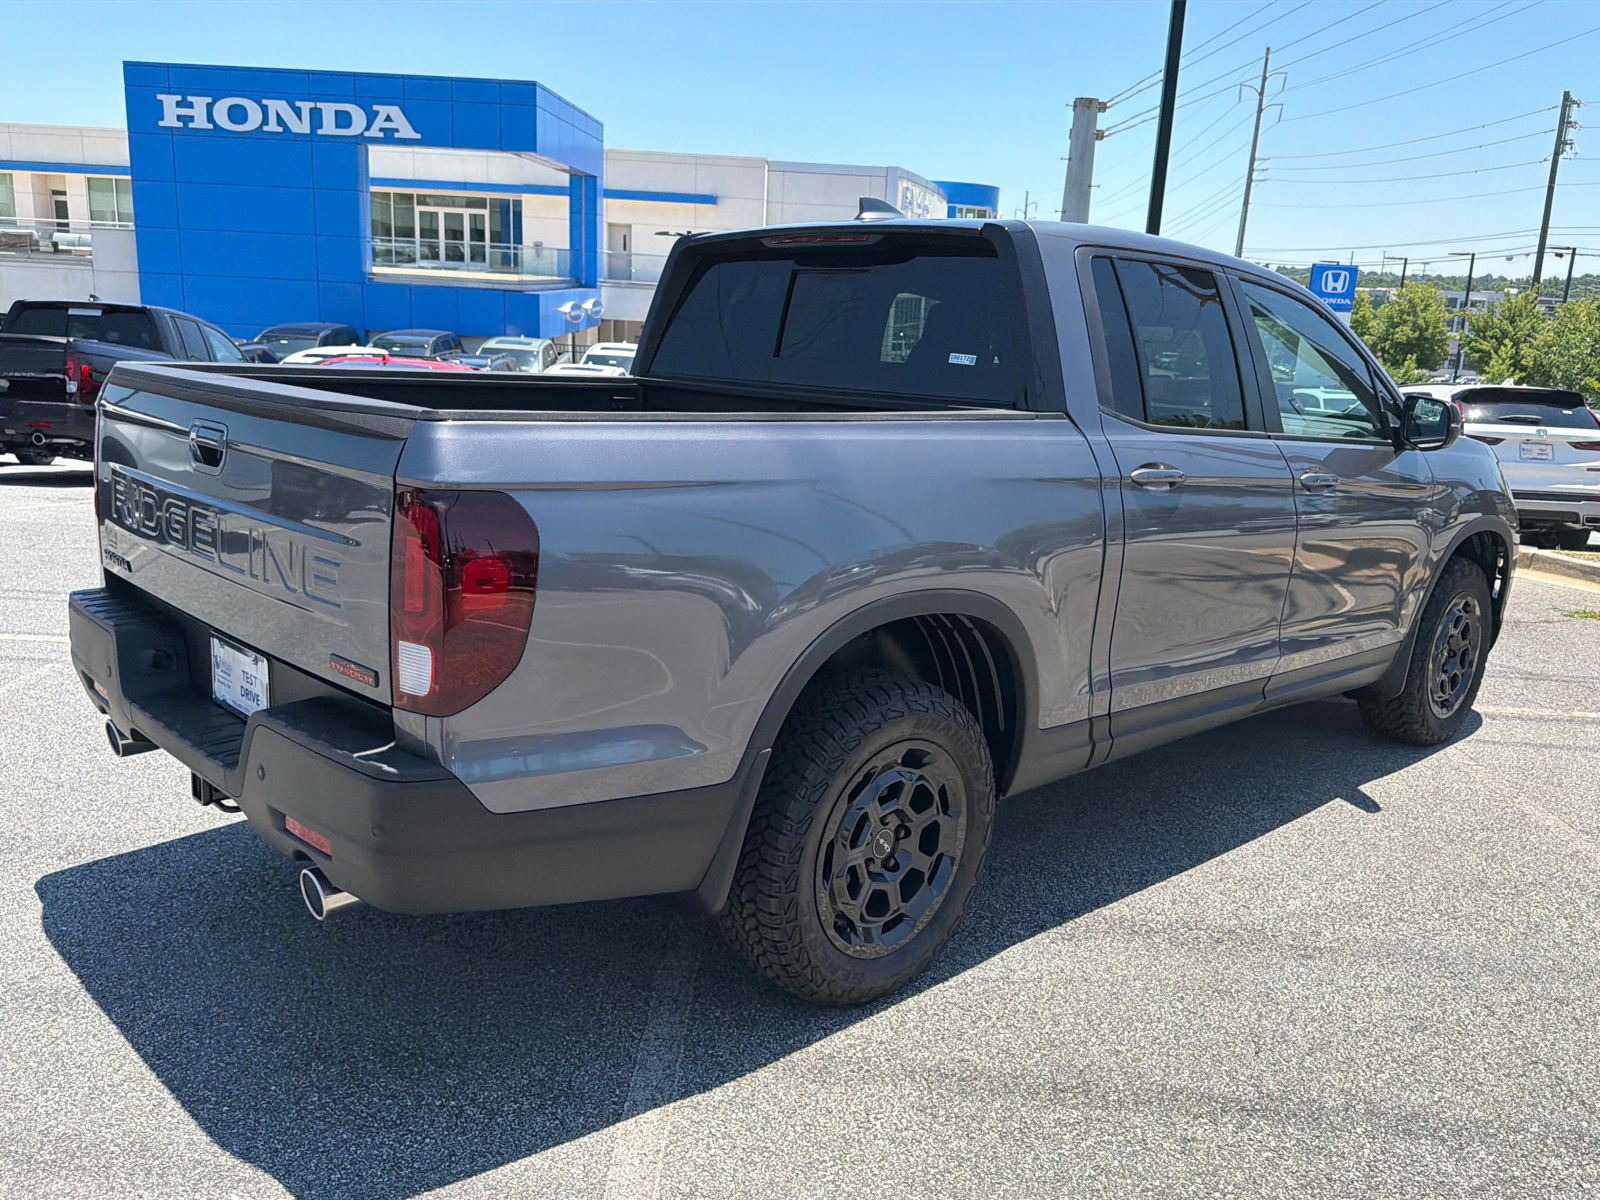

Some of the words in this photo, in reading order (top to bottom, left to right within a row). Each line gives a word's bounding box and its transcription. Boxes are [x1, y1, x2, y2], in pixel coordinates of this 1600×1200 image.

[156, 94, 421, 139] HONDA
[1321, 297, 1351, 305] ONDA
[111, 475, 342, 609] RIDGELINE
[241, 669, 258, 688] TEST
[240, 685, 261, 706] DRIVE
